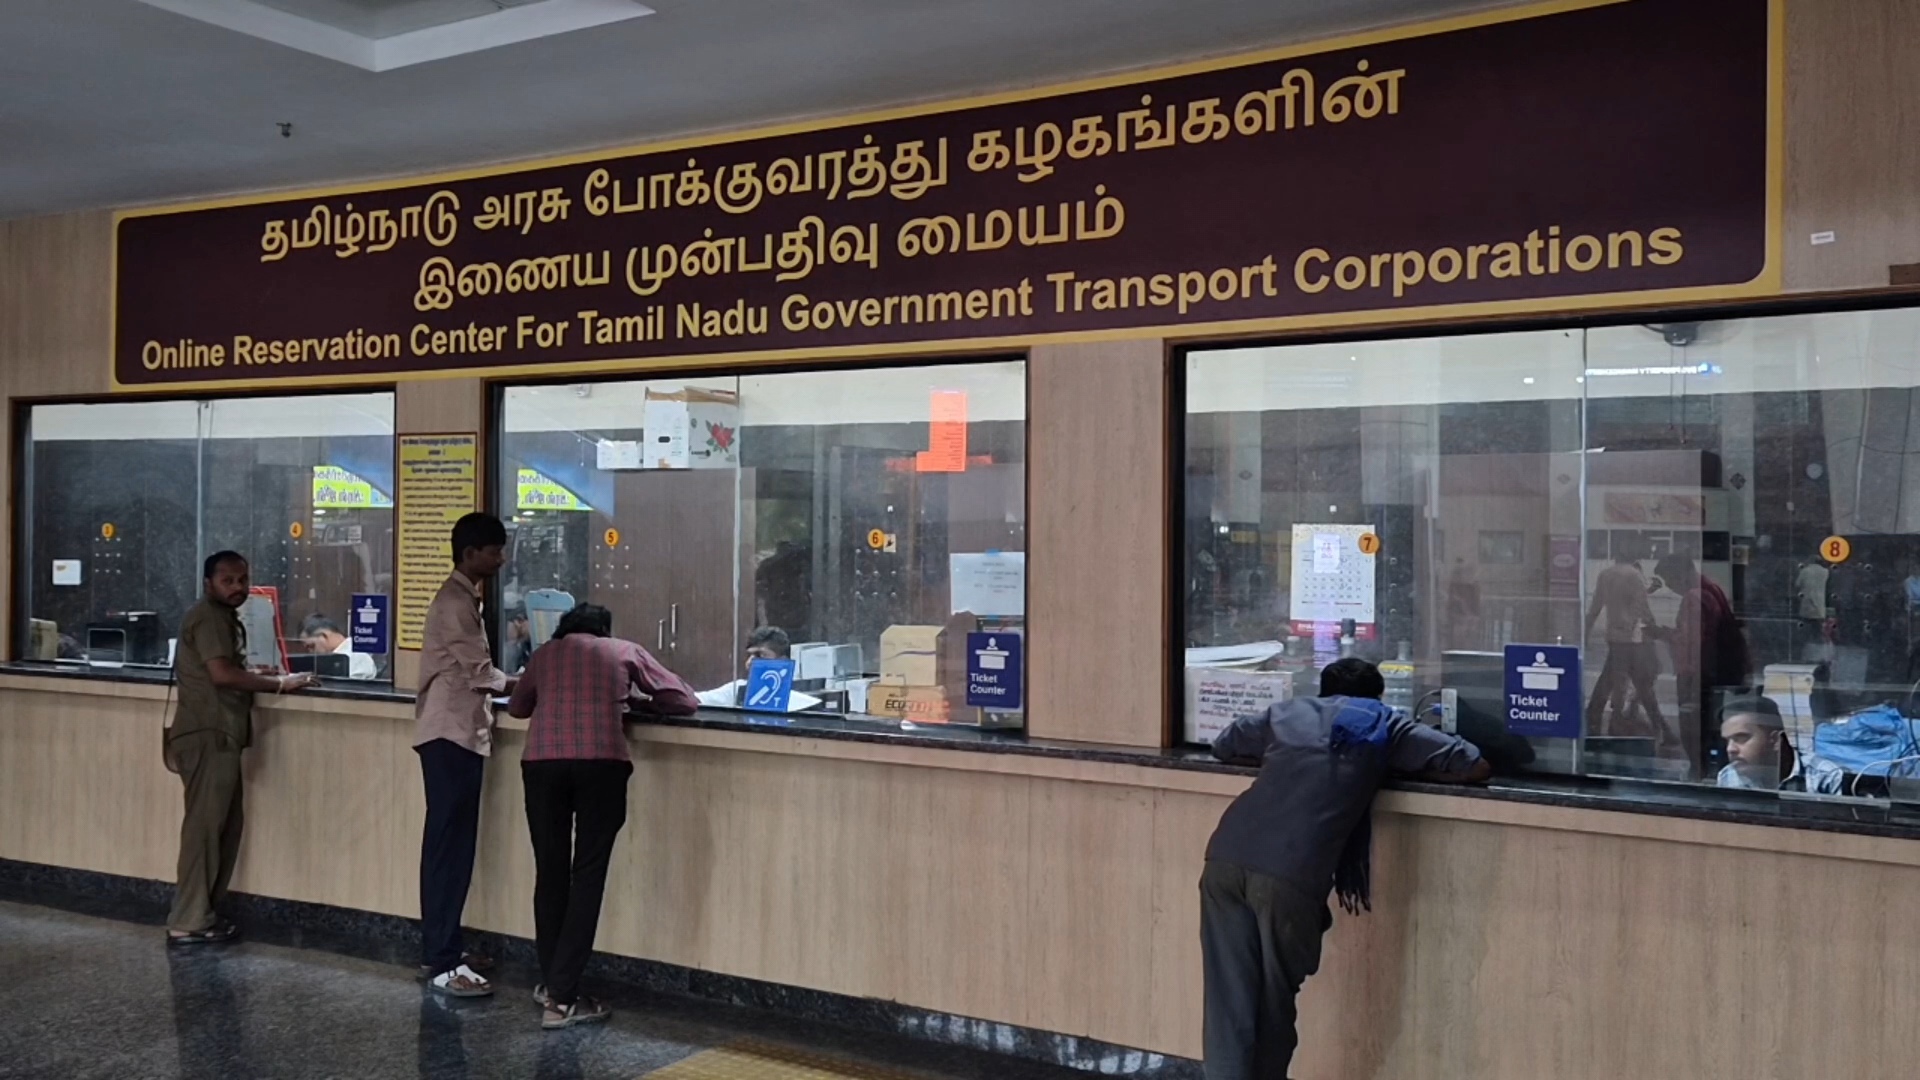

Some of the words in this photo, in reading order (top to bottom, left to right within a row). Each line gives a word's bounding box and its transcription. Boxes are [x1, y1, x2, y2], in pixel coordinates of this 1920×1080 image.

[261, 191, 459, 262] தமிழ்நாடு
[474, 188, 572, 234] அரசு
[585, 135, 948, 217] போக்குவரத்து
[967, 60, 1406, 182] கழகங்களின்
[414, 251, 610, 311] இணைய
[626, 216, 878, 296] முன்பதிவு
[898, 185, 1125, 257] மையம்
[142, 338, 226, 370] Online
[234, 330, 400, 366] Reservation
[410, 323, 508, 356] Center
[516, 315, 570, 349] For
[577, 306, 664, 345] Tamil
[676, 298, 768, 339] Nadu
[780, 277, 1034, 332] Government
[1046, 254, 1278, 315] Transport
[1294, 226, 1684, 293] Corporations
[1363, 536, 1372, 551] 7
[1830, 540, 1841, 557] 8
[970, 672, 998, 683] Ticket
[969, 684, 1006, 695] Counter
[773, 696, 782, 708] T
[1509, 693, 1548, 707] Ticket
[1509, 707, 1560, 721] Counter
